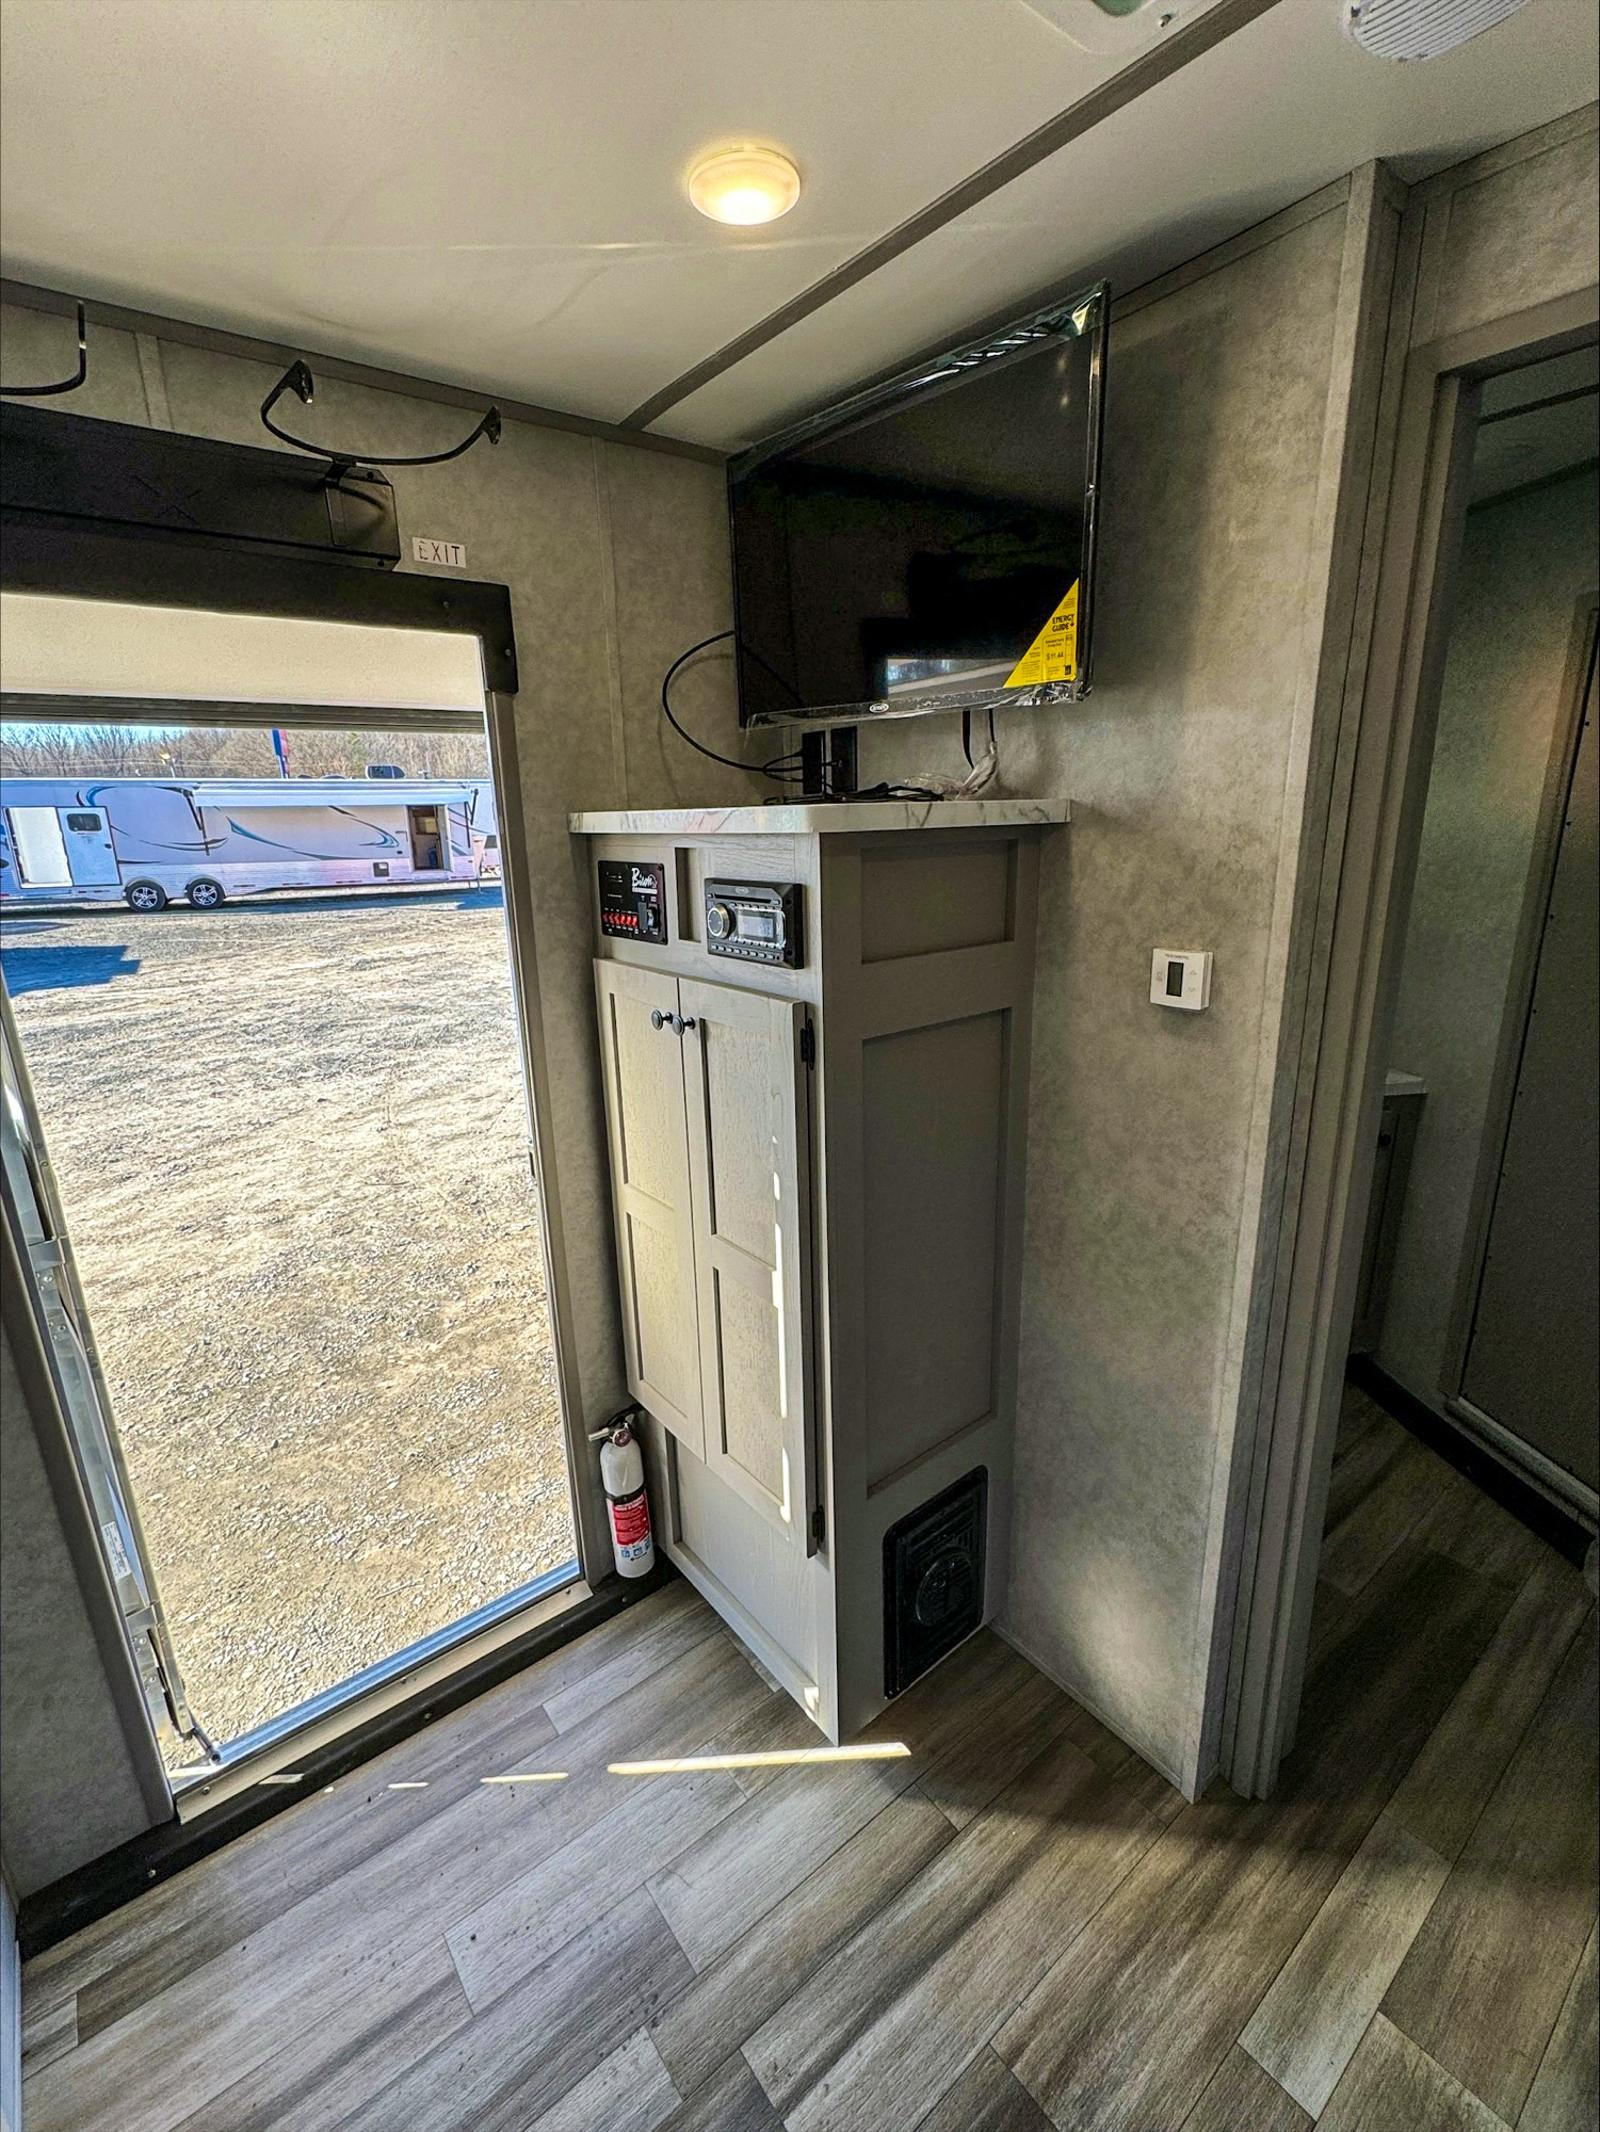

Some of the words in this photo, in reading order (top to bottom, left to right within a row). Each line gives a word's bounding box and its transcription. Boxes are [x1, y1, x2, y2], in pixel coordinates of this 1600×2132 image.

[418, 540, 460, 565] EXIT
[1052, 614, 1075, 624] ENERGY
[1052, 622, 1070, 632] GUIDE
